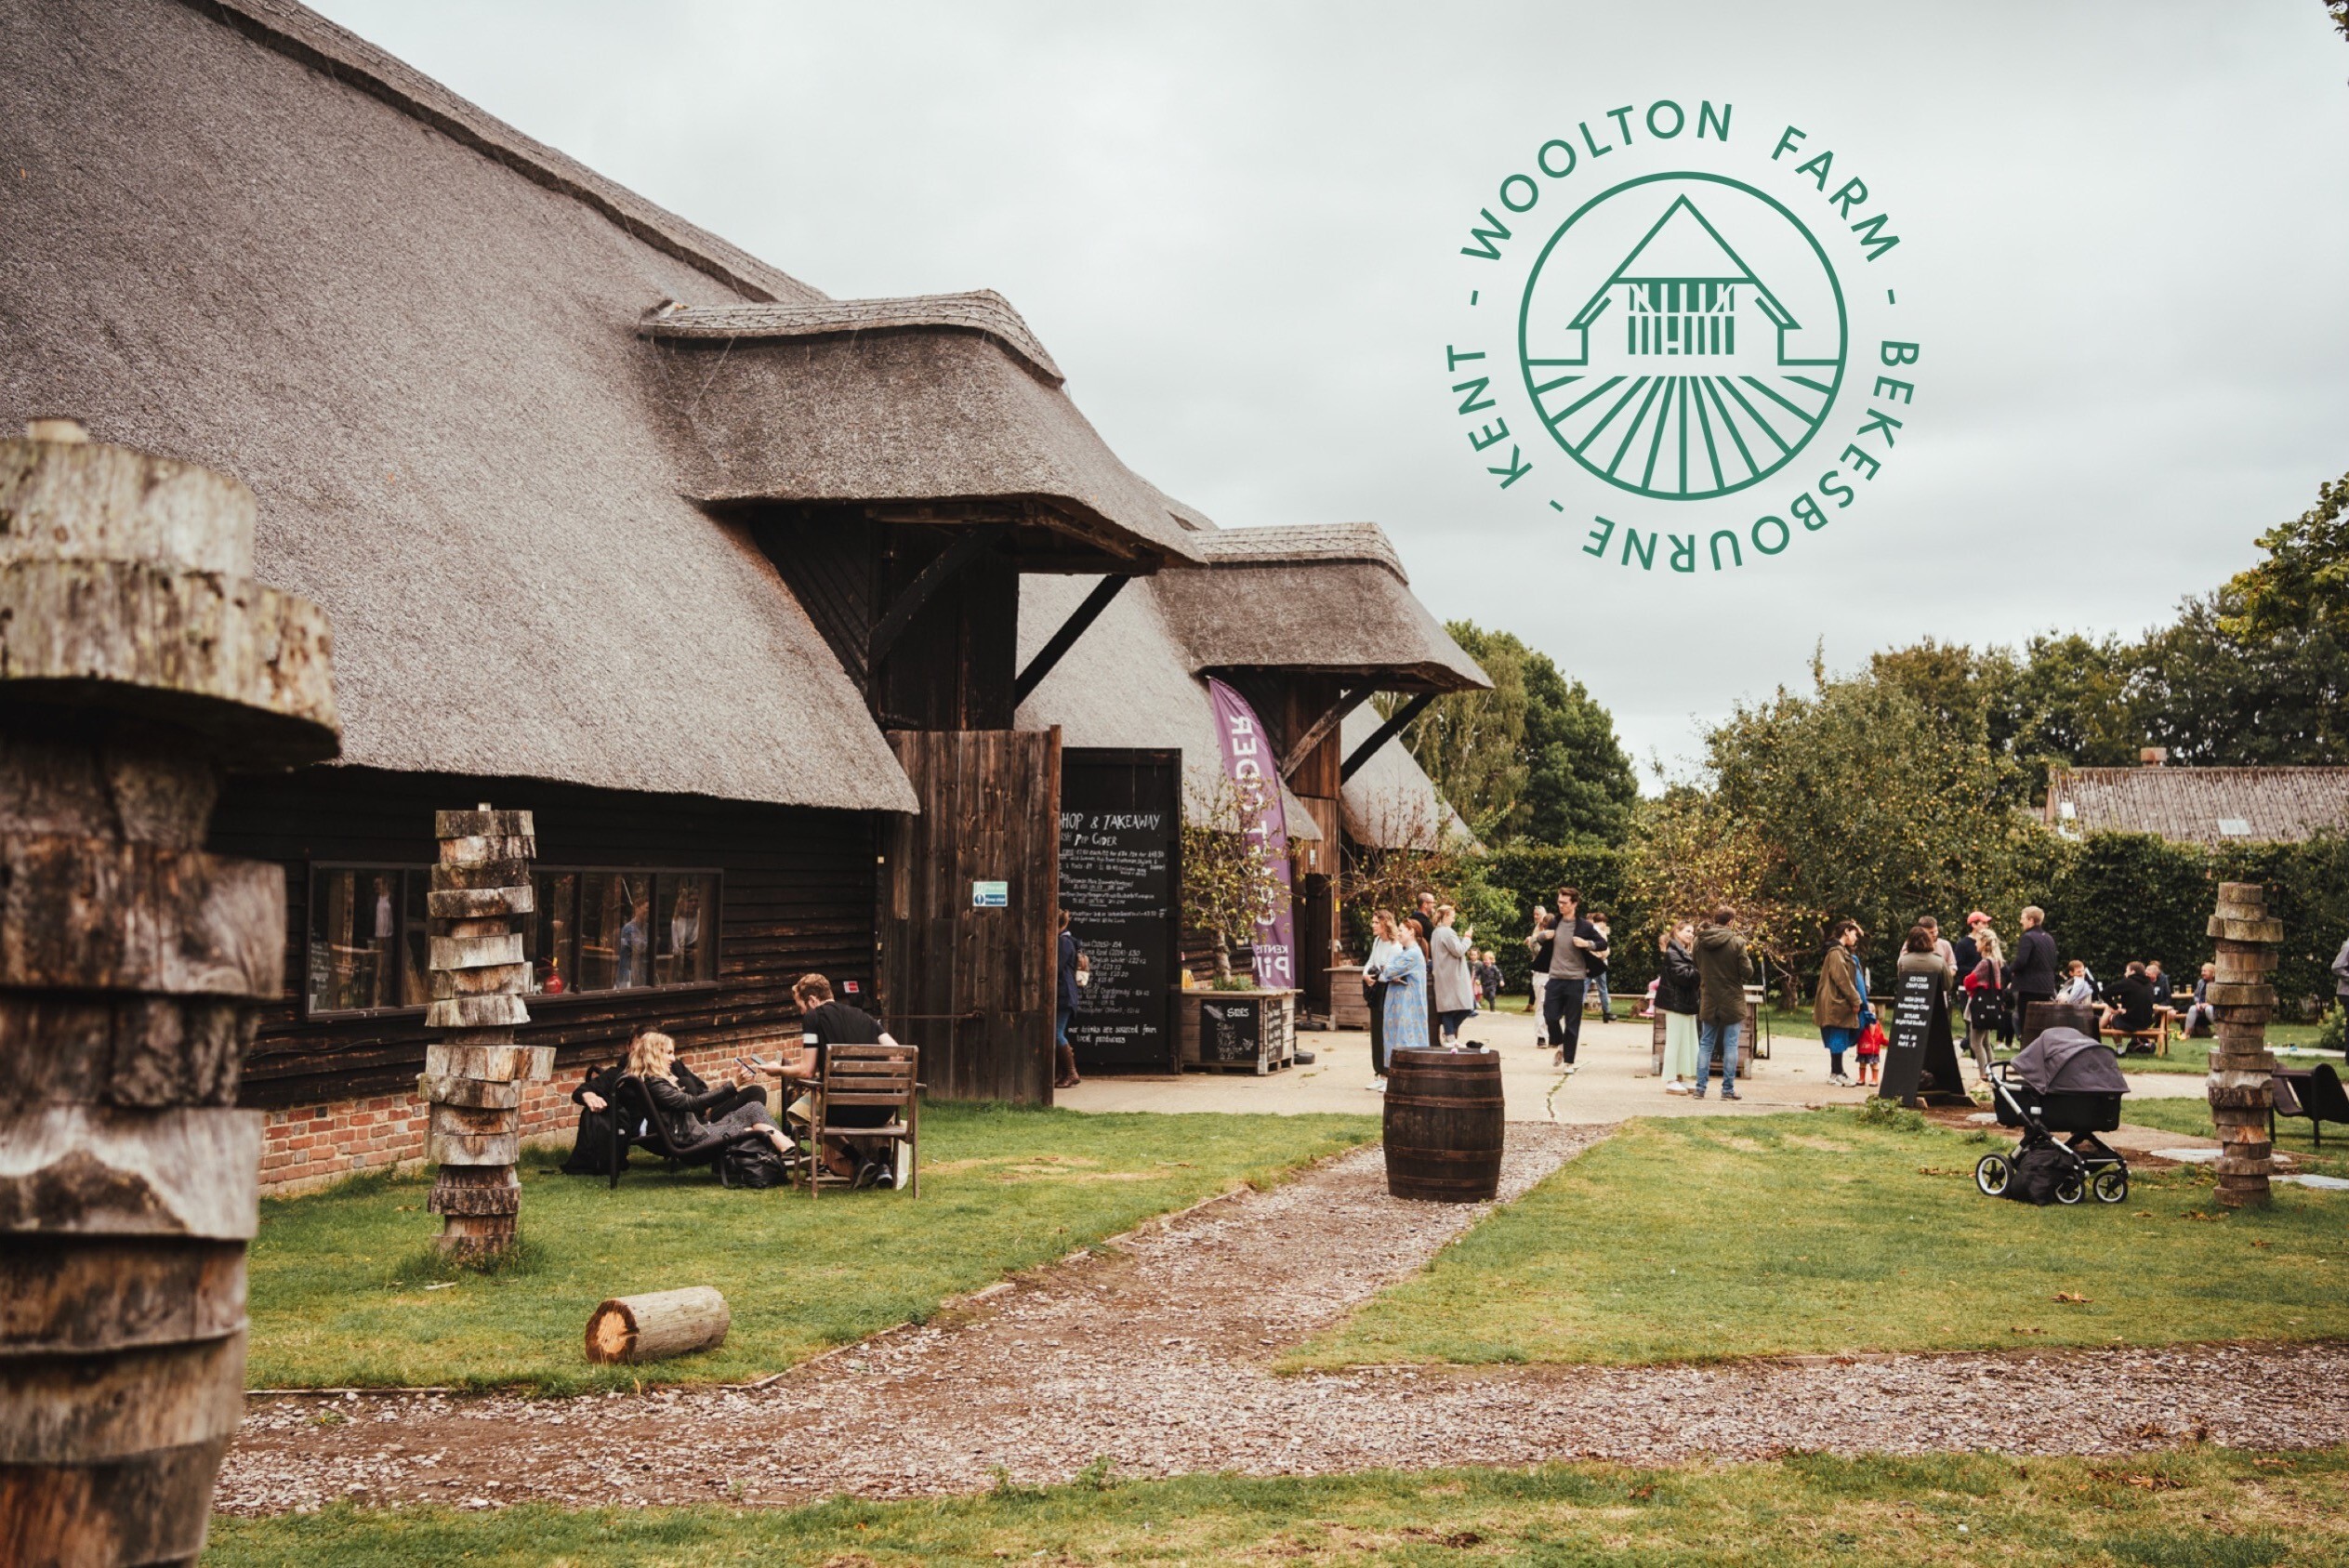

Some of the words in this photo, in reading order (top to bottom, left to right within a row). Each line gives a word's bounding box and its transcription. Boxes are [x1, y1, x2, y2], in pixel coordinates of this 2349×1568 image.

[1060, 812, 1084, 830] HOP
[1090, 816, 1099, 829] &
[1102, 814, 1160, 830] TAKEAWAY
